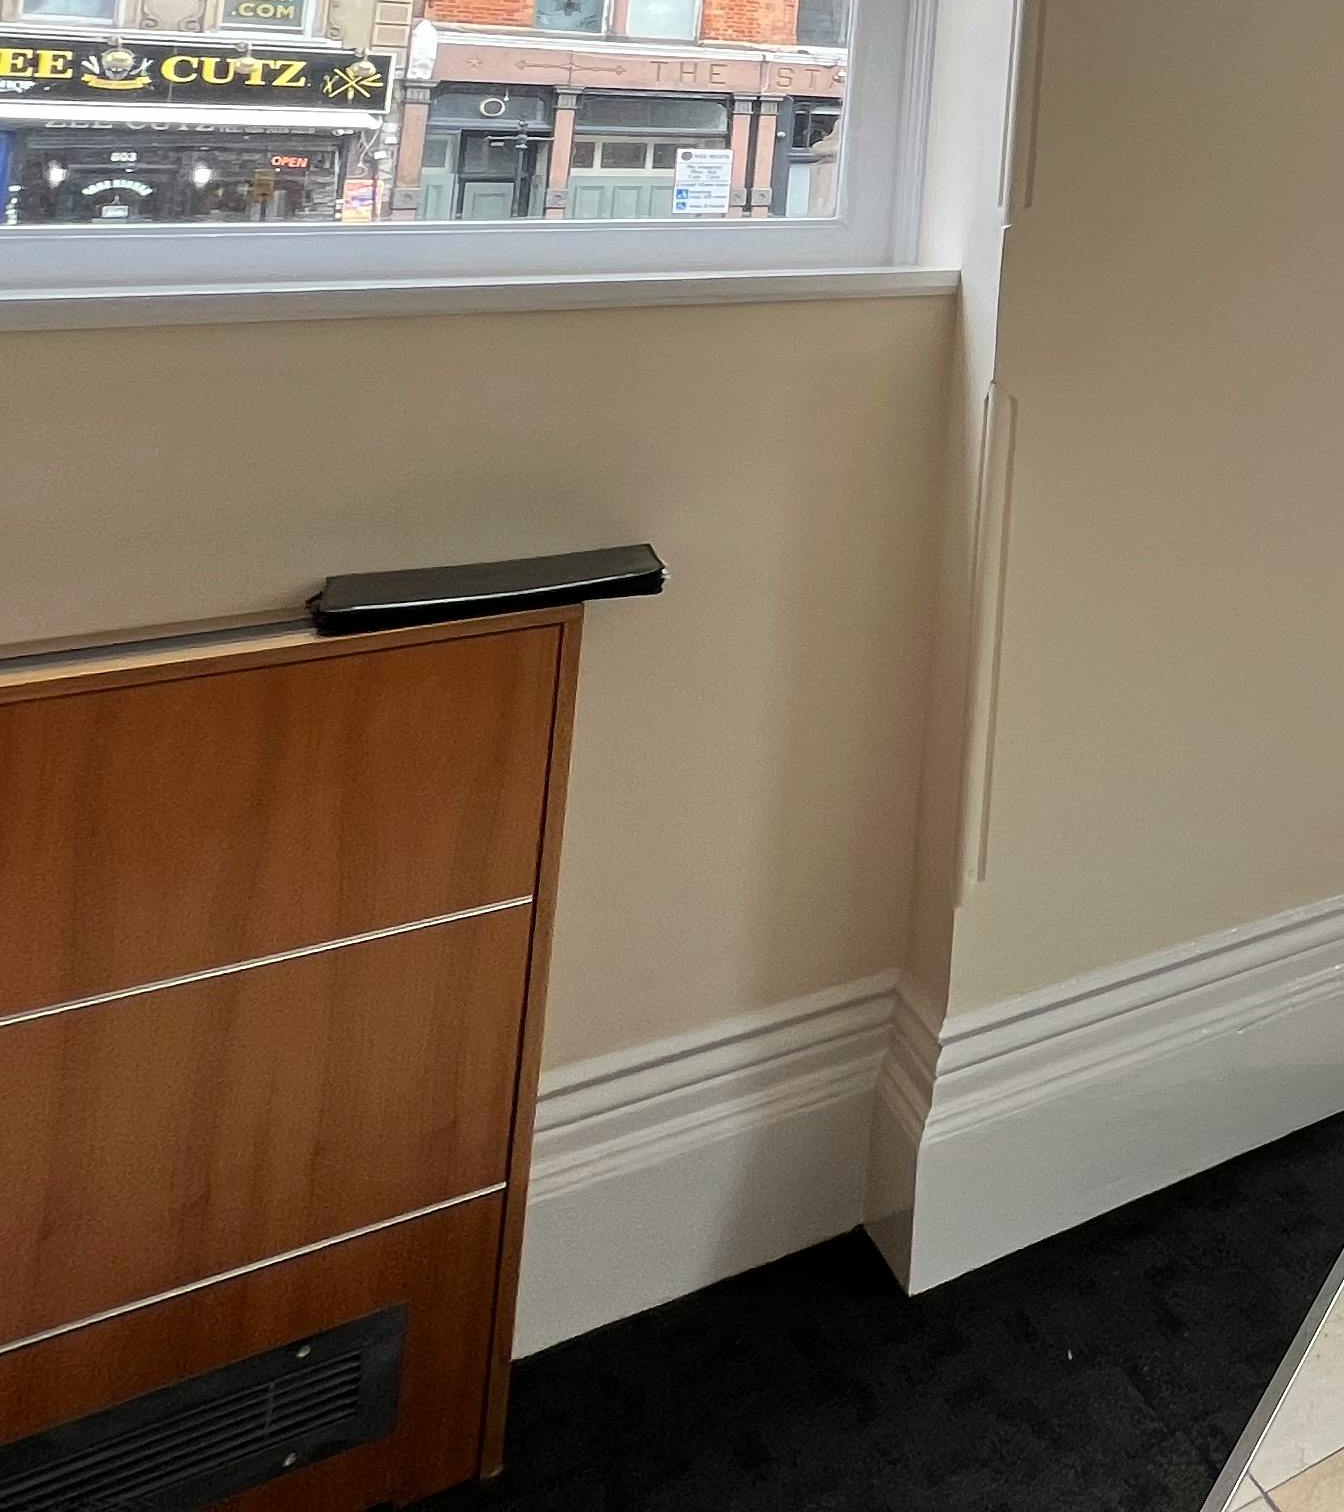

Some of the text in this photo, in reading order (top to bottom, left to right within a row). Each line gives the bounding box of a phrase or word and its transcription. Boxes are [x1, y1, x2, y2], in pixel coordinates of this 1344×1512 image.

[160, 55, 308, 87] CUTZ
[650, 60, 727, 85] THE
[271, 154, 311, 169] OPEN
